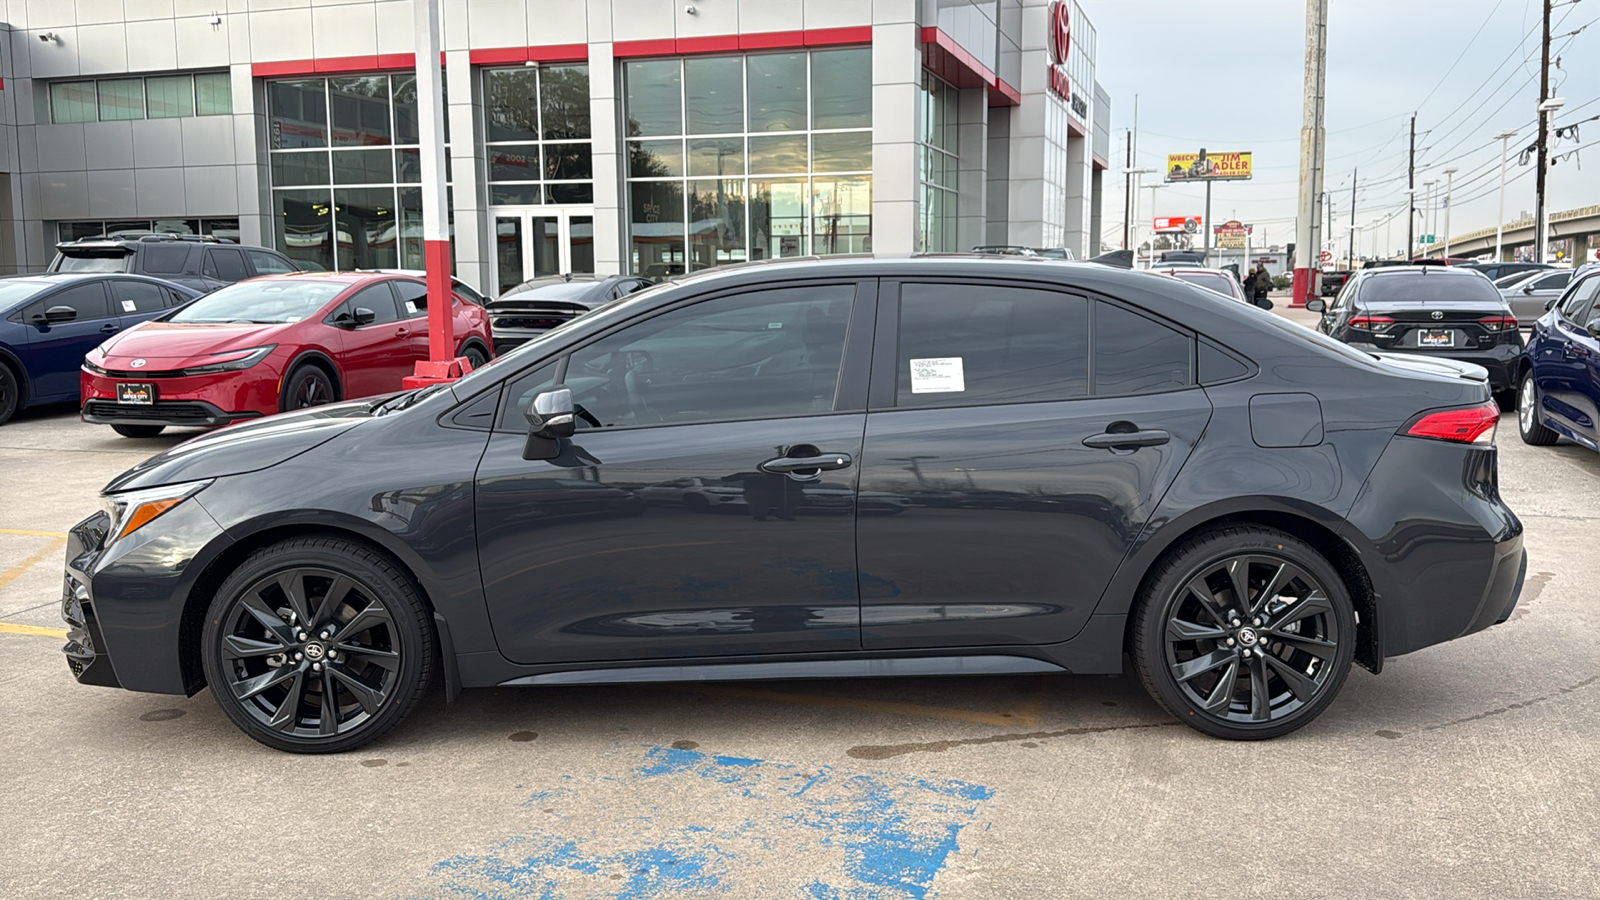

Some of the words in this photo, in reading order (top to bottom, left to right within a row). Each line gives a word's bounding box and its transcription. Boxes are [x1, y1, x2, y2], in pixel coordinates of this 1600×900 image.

[505, 154, 526, 163] 2002
[1221, 153, 1241, 162] JIM
[1212, 161, 1248, 170] ADLER
